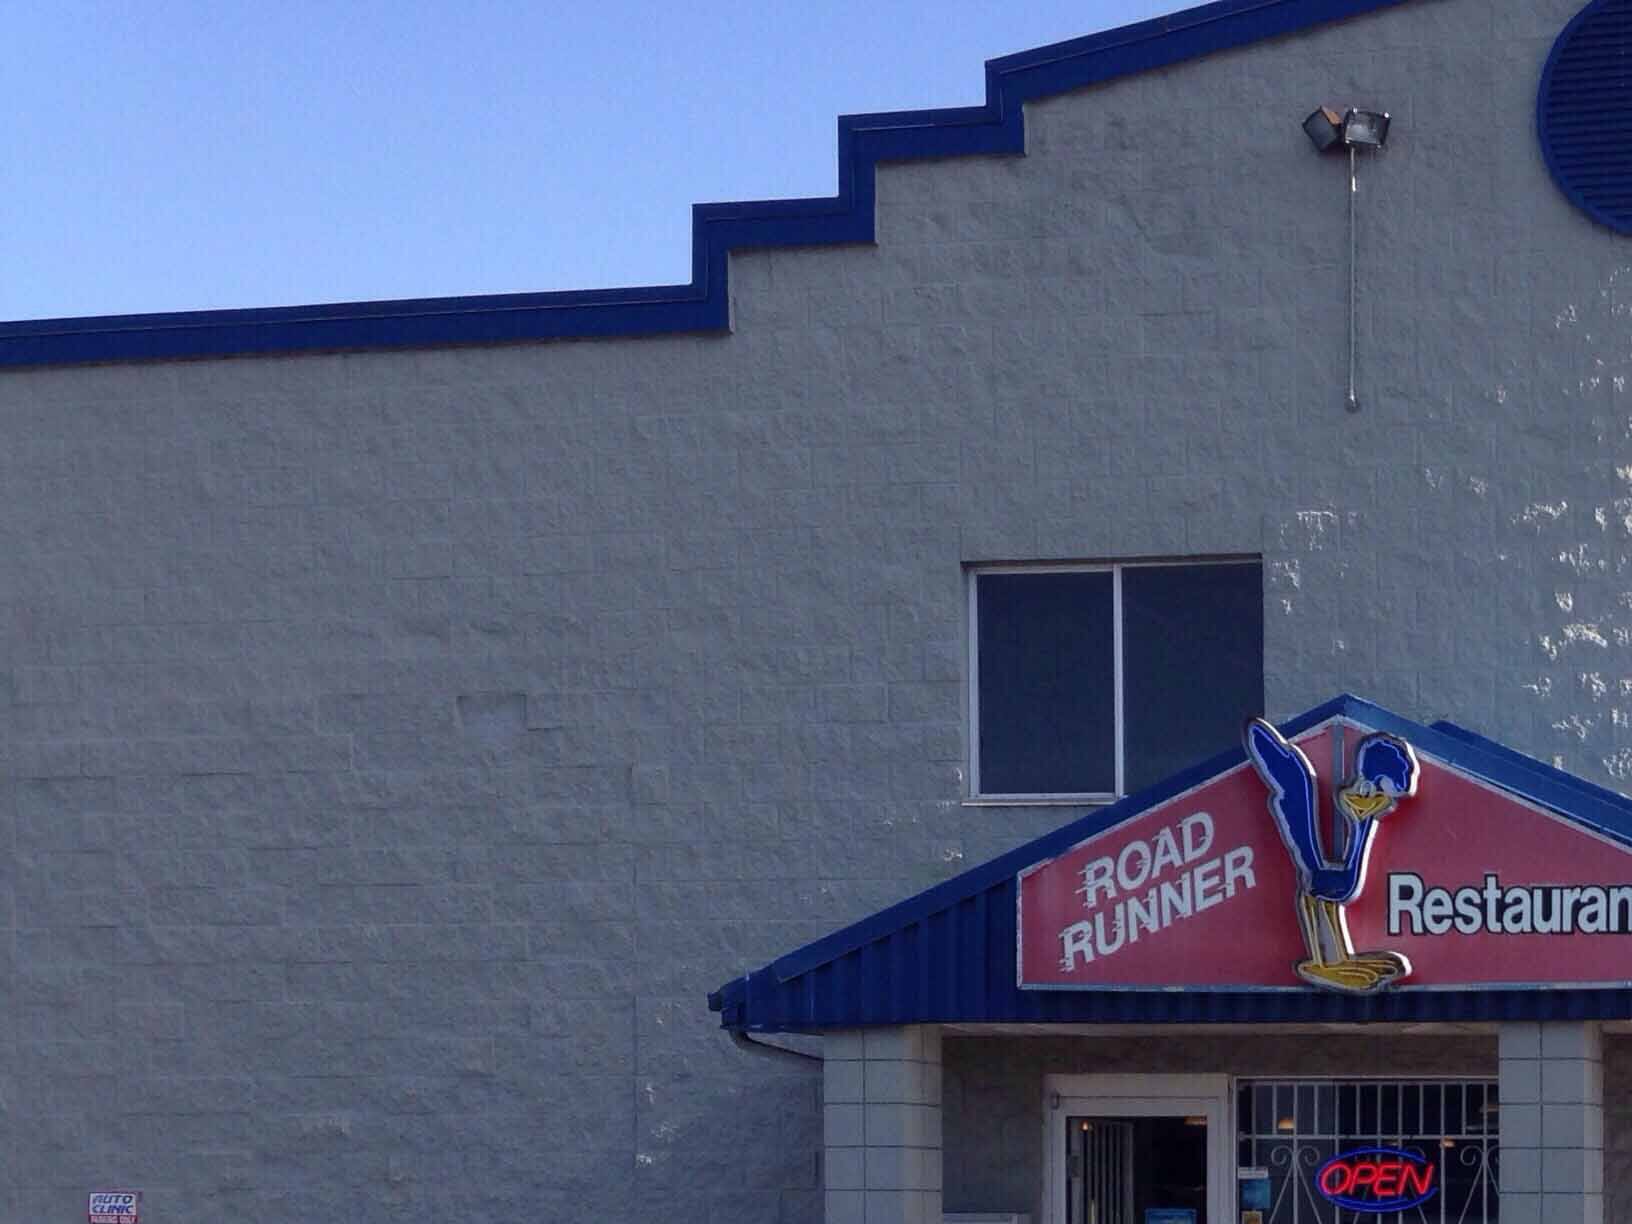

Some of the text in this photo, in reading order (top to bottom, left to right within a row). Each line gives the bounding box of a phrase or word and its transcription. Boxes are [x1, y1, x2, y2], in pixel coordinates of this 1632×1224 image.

[1076, 812, 1214, 908] ROAD
[1058, 846, 1256, 972] RUNNER
[1320, 1162, 1435, 1197] OPEN
[92, 1204, 134, 1214] CLINIC
[93, 1194, 133, 1204] AUTO
